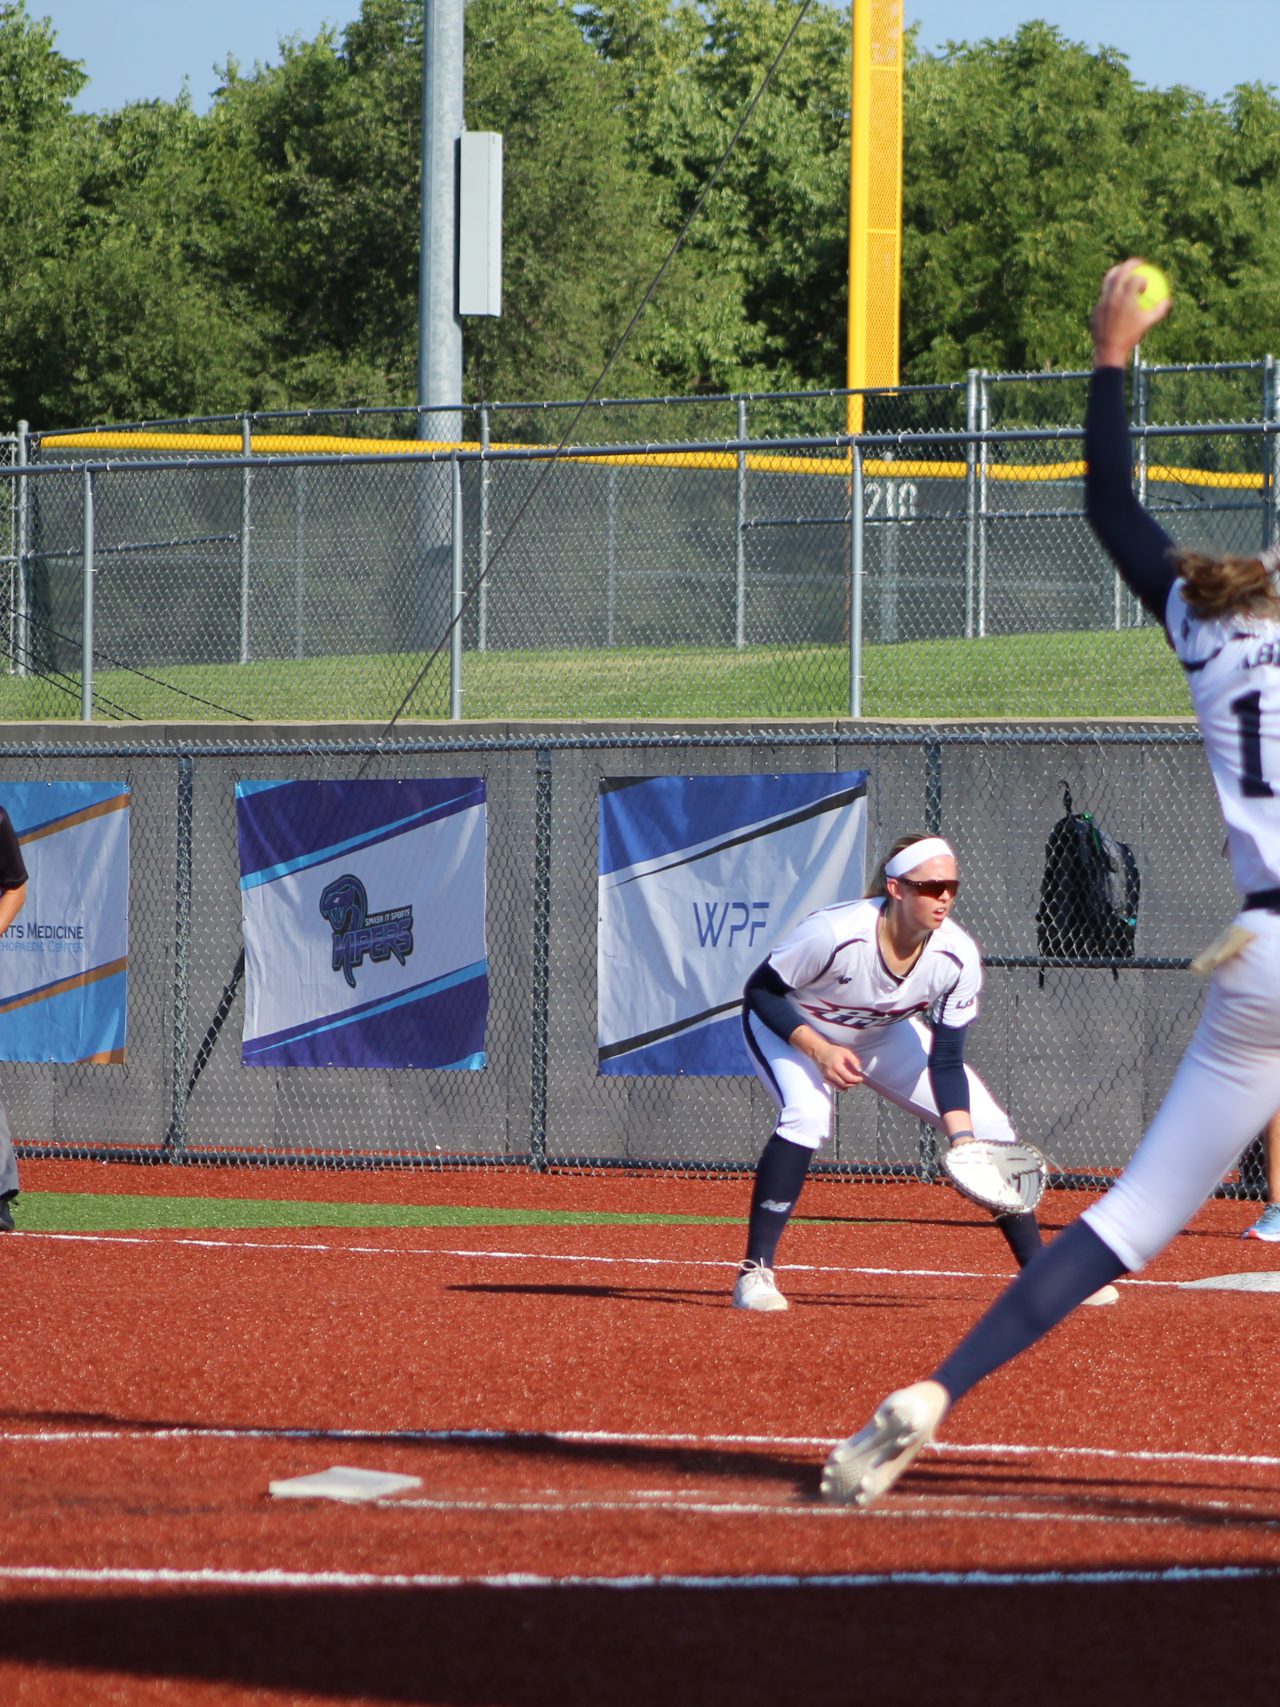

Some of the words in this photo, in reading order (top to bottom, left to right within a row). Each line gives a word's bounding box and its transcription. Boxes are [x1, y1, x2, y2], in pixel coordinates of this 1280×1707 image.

[27, 922, 84, 940] MEDICINE
[364, 914, 384, 927] SMASH
[390, 908, 411, 921] SPORTS
[693, 902, 770, 947] WPF
[332, 917, 413, 989] VIPERS
